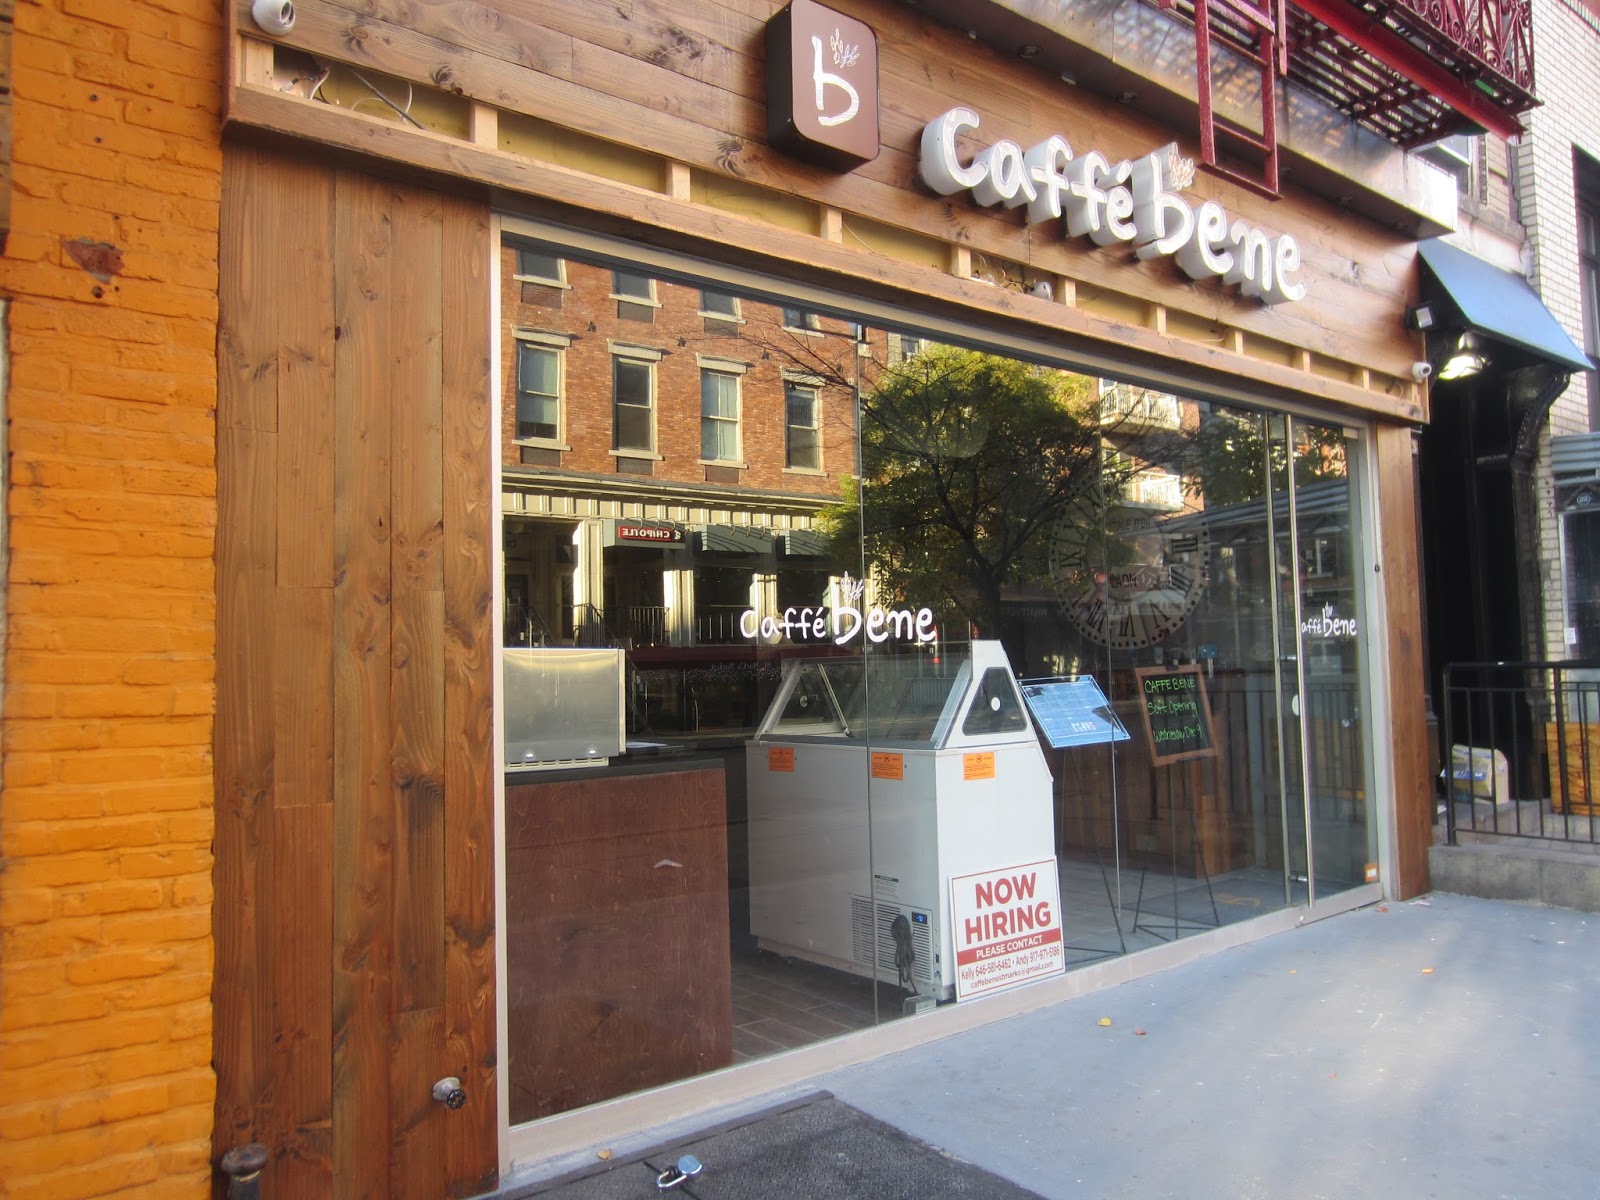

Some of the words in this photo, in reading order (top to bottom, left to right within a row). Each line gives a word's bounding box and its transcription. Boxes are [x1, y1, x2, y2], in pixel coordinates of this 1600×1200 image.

[1136, 146, 1307, 304] bene
[831, 580, 936, 645] bene
[1301, 618, 1322, 634] affé
[1322, 607, 1357, 637] bene
[1144, 679, 1172, 694] CAFFE
[1172, 677, 1195, 690] BENE
[1147, 700, 1167, 715] Soft
[1168, 700, 1198, 718] Opening
[975, 872, 1037, 909] NOW
[964, 901, 1052, 945] HIRING
[976, 944, 1006, 959] PLEASE
[1006, 934, 1044, 951] CONTACT
[961, 968, 975, 981] Kelly
[1015, 955, 1029, 966] Andy
